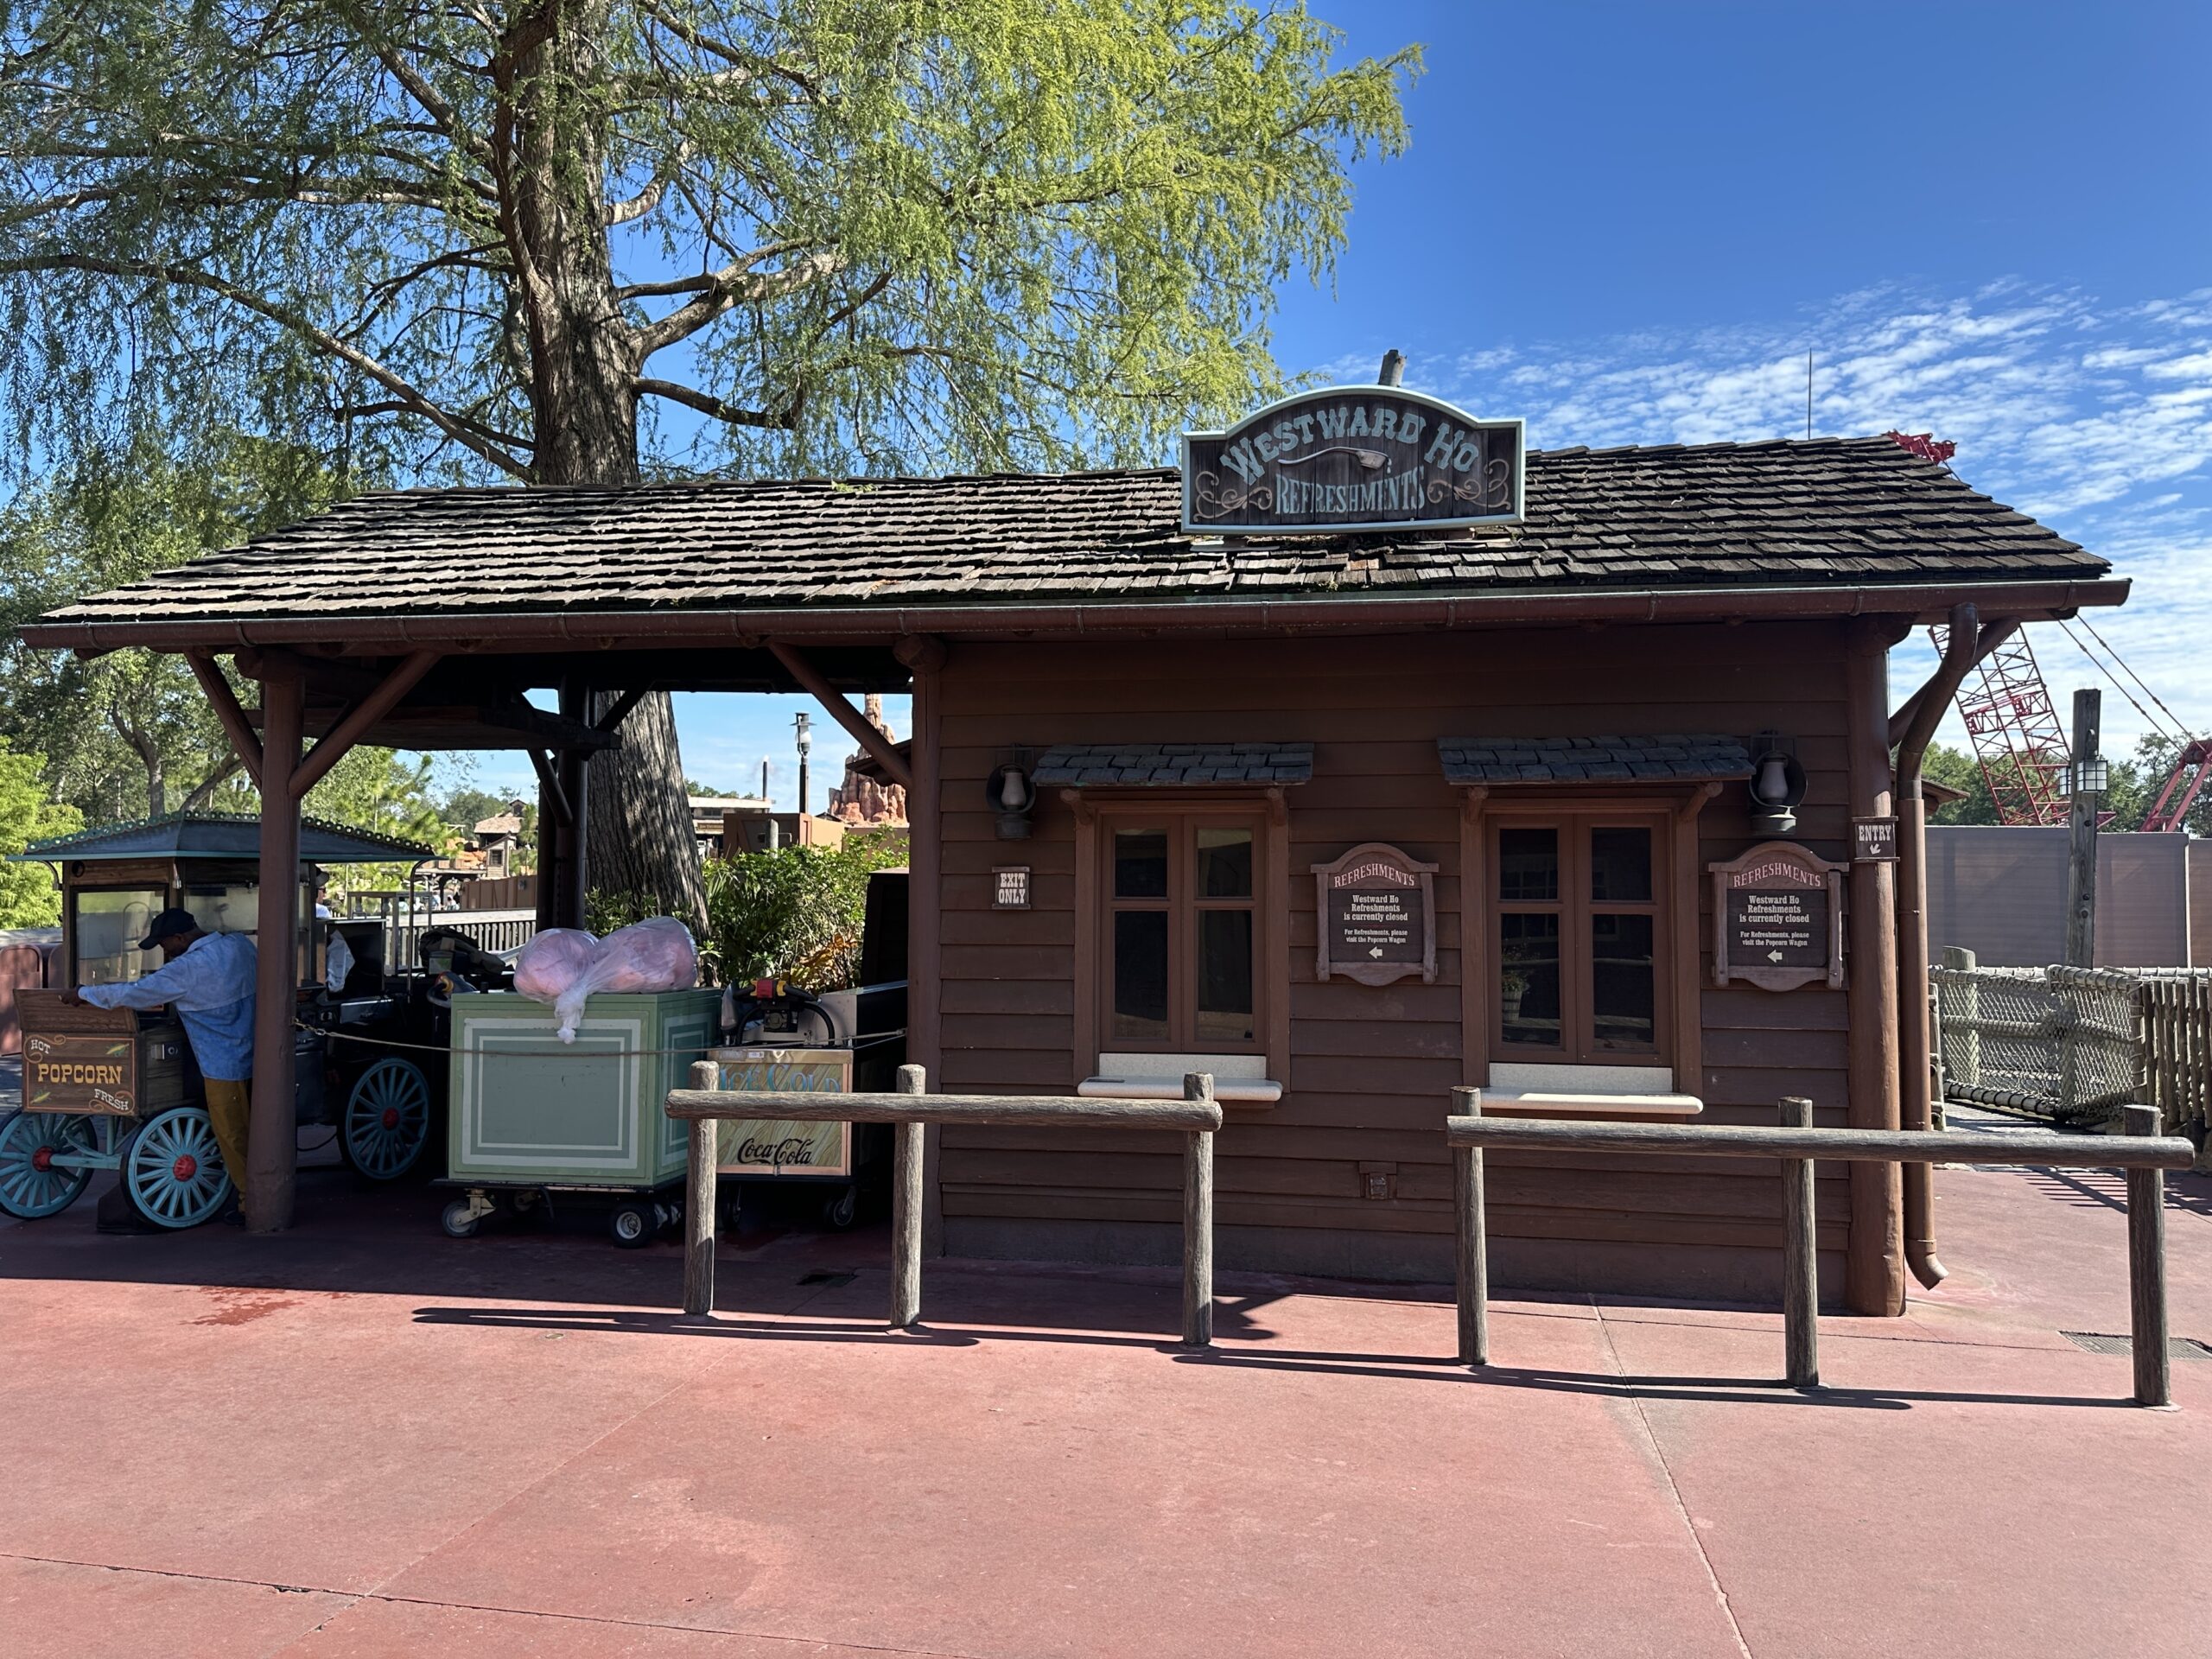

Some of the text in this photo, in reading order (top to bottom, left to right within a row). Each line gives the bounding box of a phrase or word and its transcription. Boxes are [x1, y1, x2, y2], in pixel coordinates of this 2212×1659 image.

[1219, 406, 1479, 486] WESTWARD HO
[1274, 465, 1426, 516] REFRESHMENTS
[1858, 825, 1892, 842] ENTRY
[1000, 873, 1026, 888] EXIT
[1334, 863, 1415, 888] REFRESHMENTS
[1733, 862, 1821, 888] REFRESHMENTS
[998, 888, 1026, 904] ONLY
[1352, 894, 1400, 903] Westward Ho
[1749, 895, 1800, 905] Westward Ho
[1351, 904, 1401, 912] Refreshments
[1747, 905, 1802, 913] Refreshments
[1344, 912, 1408, 923] is currently closed
[1739, 913, 1810, 925] is currently closed
[30, 1039, 51, 1054] HOT
[37, 1063, 123, 1085] POPCORN
[94, 1089, 130, 1111] FRESH
[737, 1137, 816, 1166] Coca-Cola
